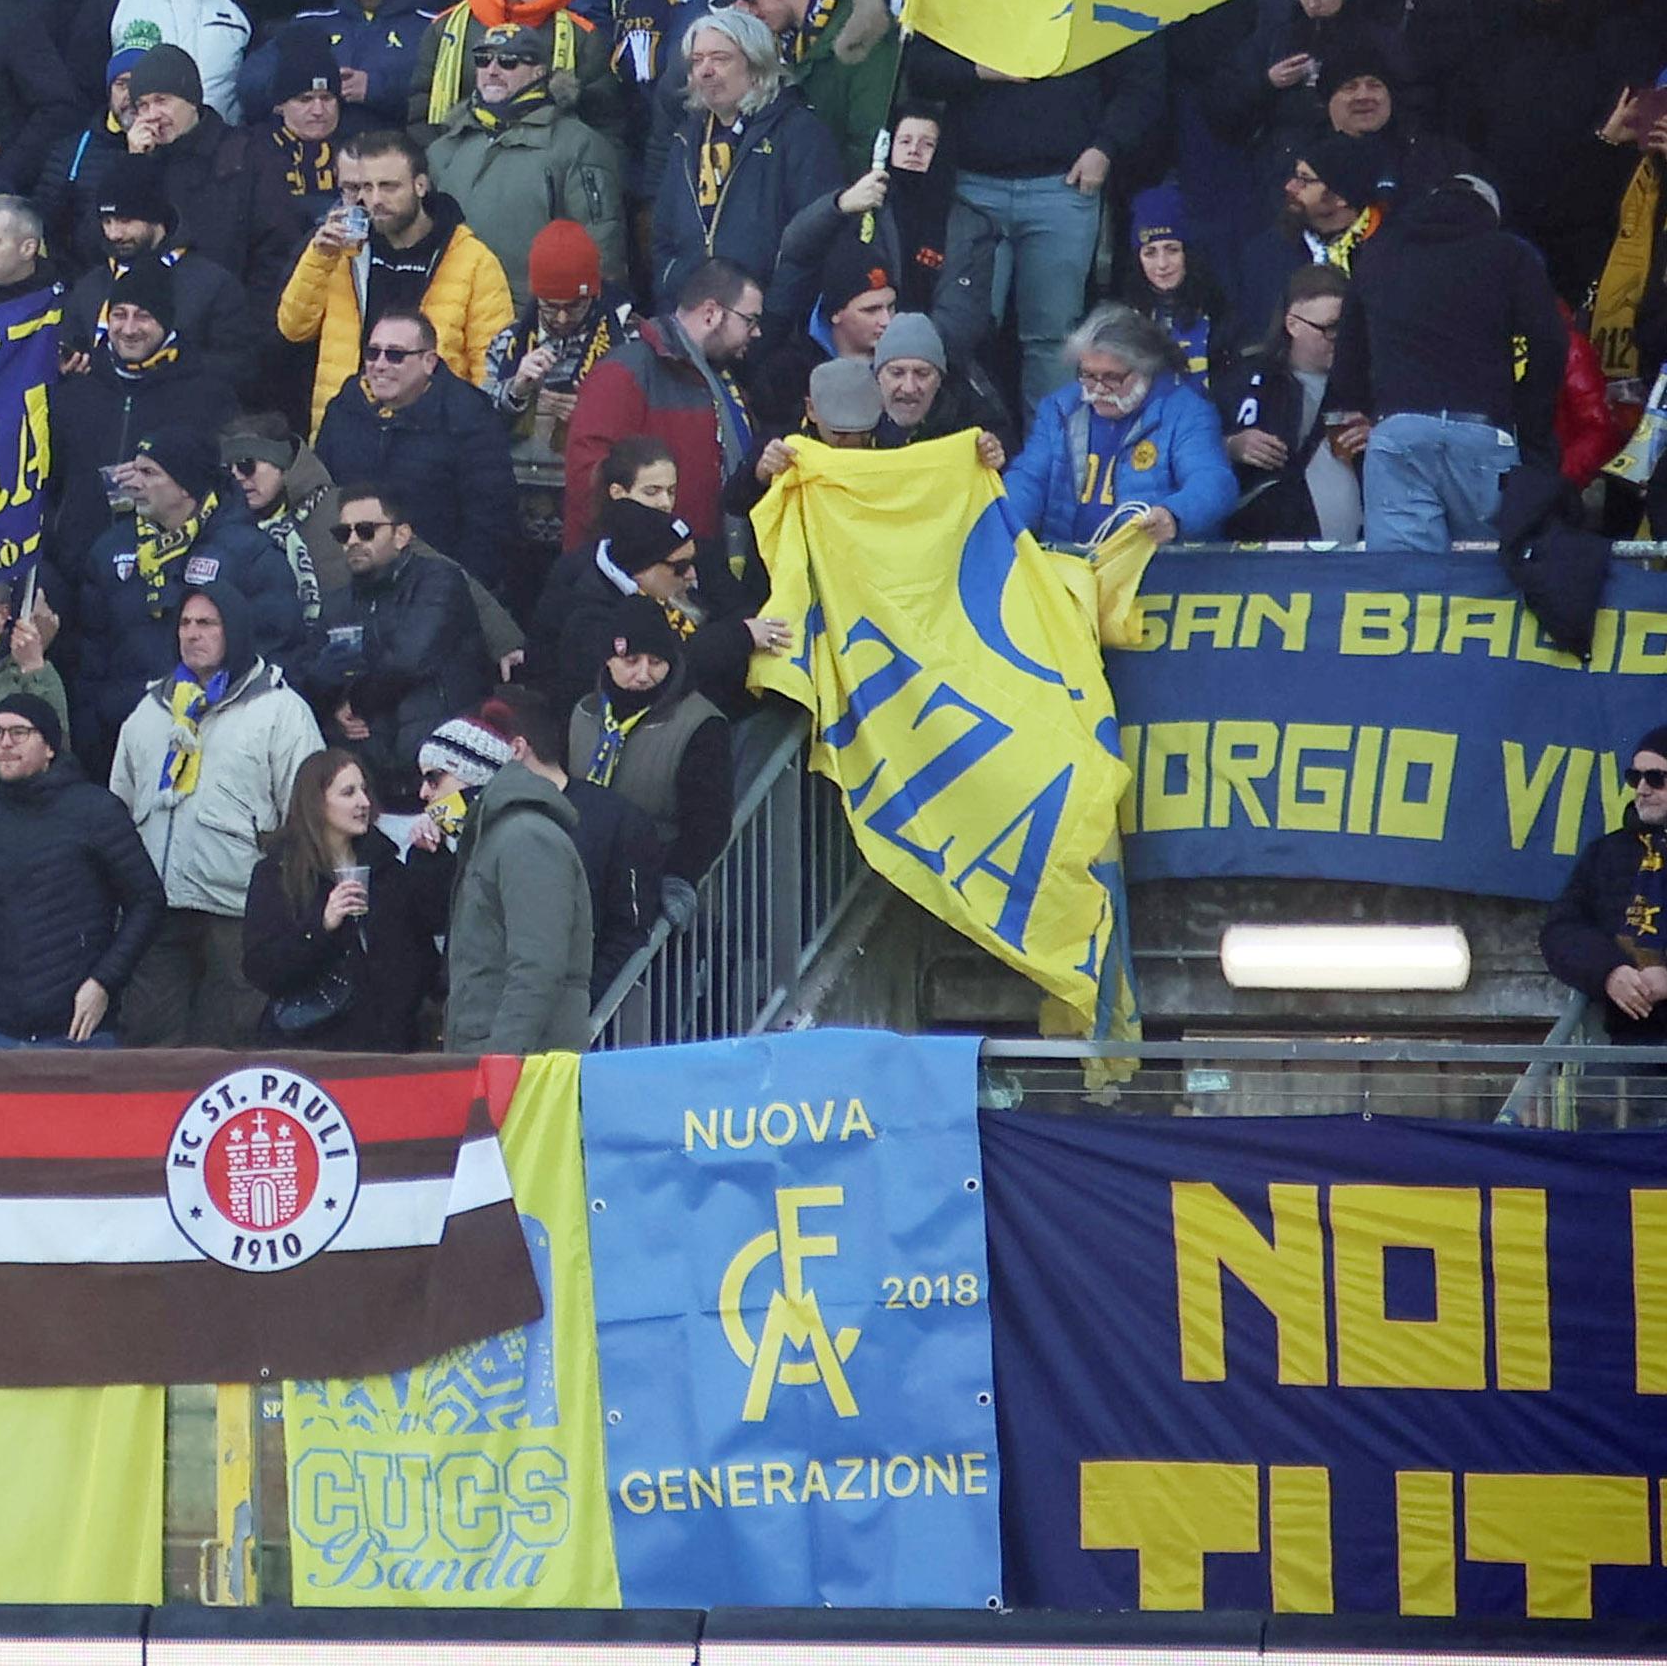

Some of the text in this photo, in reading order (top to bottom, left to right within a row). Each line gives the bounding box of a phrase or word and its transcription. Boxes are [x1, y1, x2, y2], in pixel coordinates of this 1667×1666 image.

[1114, 593, 1312, 651] SAN
[1121, 720, 1635, 857] IORGIO VIV
[173, 1074, 349, 1170] FC ST. PAULI
[683, 1099, 876, 1151] NUOVA
[230, 1231, 303, 1266] 1910
[881, 1273, 979, 1310] 2018
[1171, 1182, 1551, 1392] NOI
[262, 1401, 283, 1420] SP
[293, 1445, 569, 1553] CUCS
[619, 1452, 988, 1515] GENERAZIONE
[308, 1531, 548, 1593] Banda
